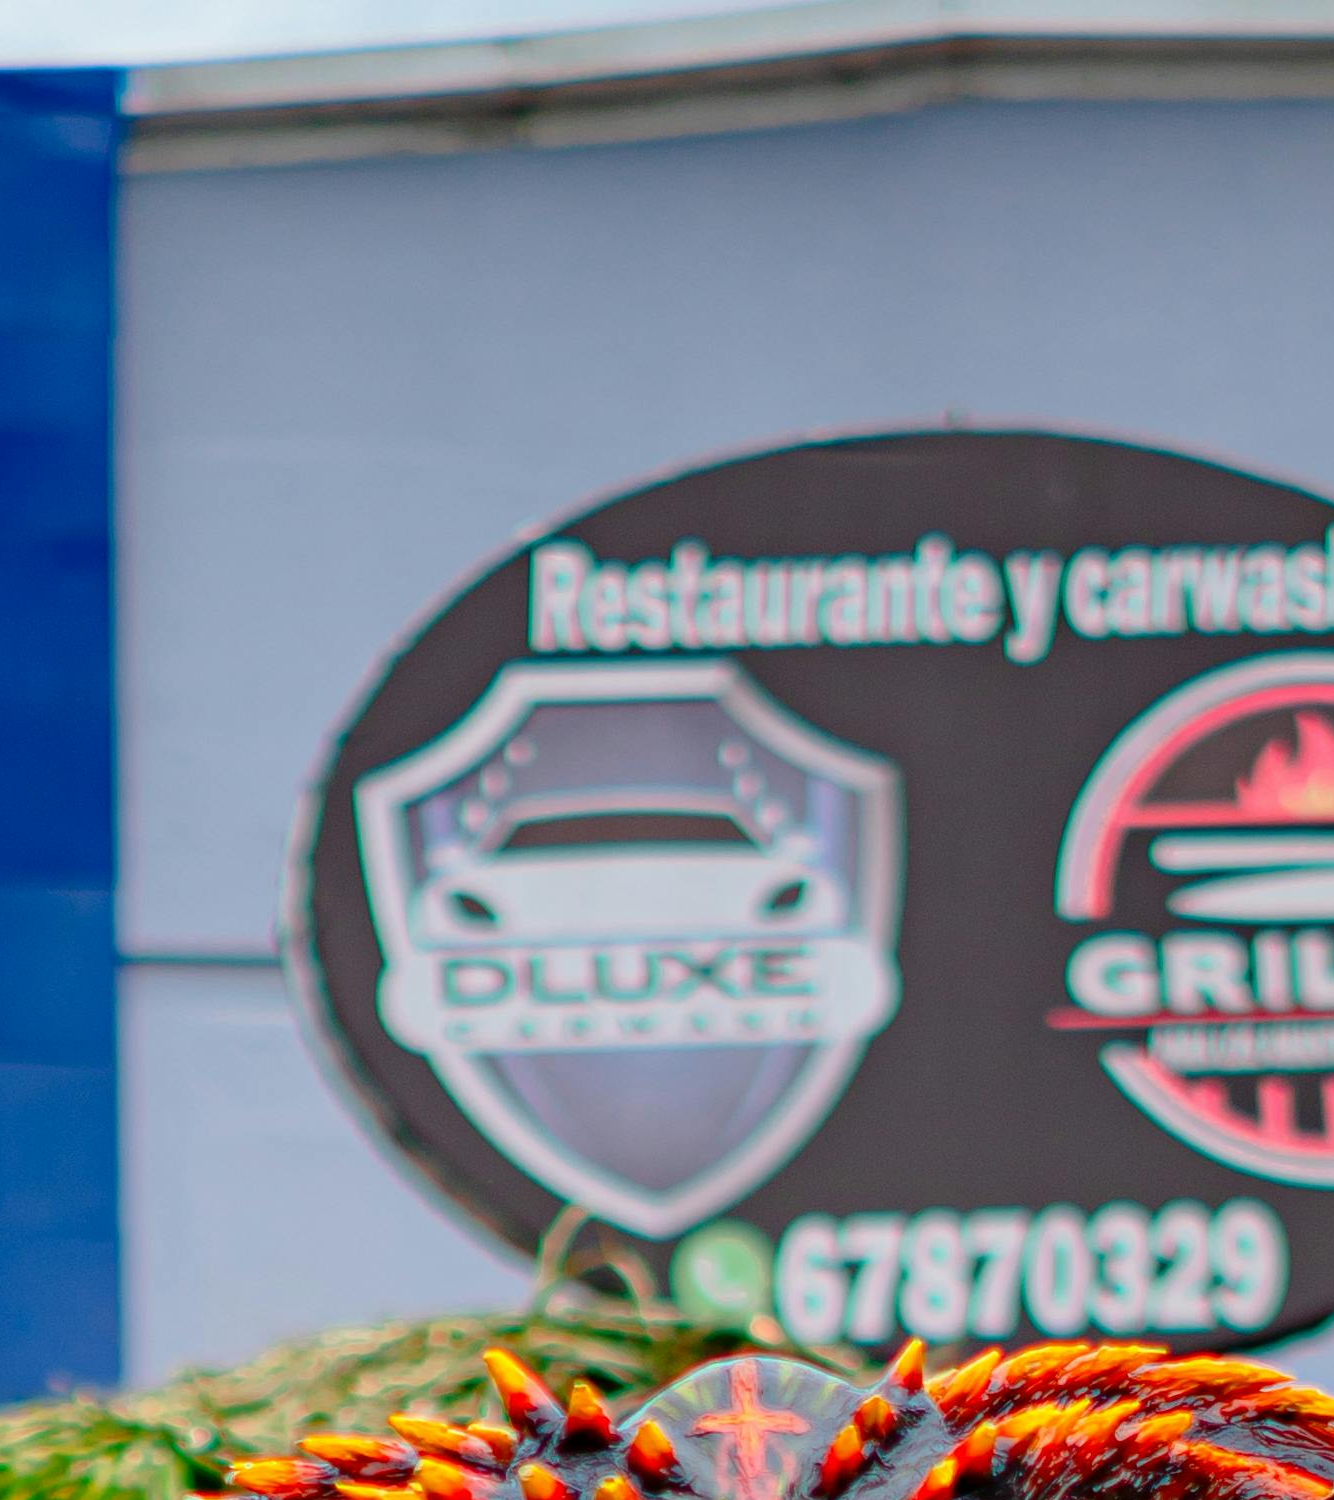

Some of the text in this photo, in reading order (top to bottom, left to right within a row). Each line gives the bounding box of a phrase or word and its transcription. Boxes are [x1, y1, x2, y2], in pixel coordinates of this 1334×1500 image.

[529, 531, 1004, 652] Restaurante
[1005, 550, 1064, 665] y
[442, 945, 816, 1004] DLUXE
[775, 1197, 1290, 1344] 67870329
